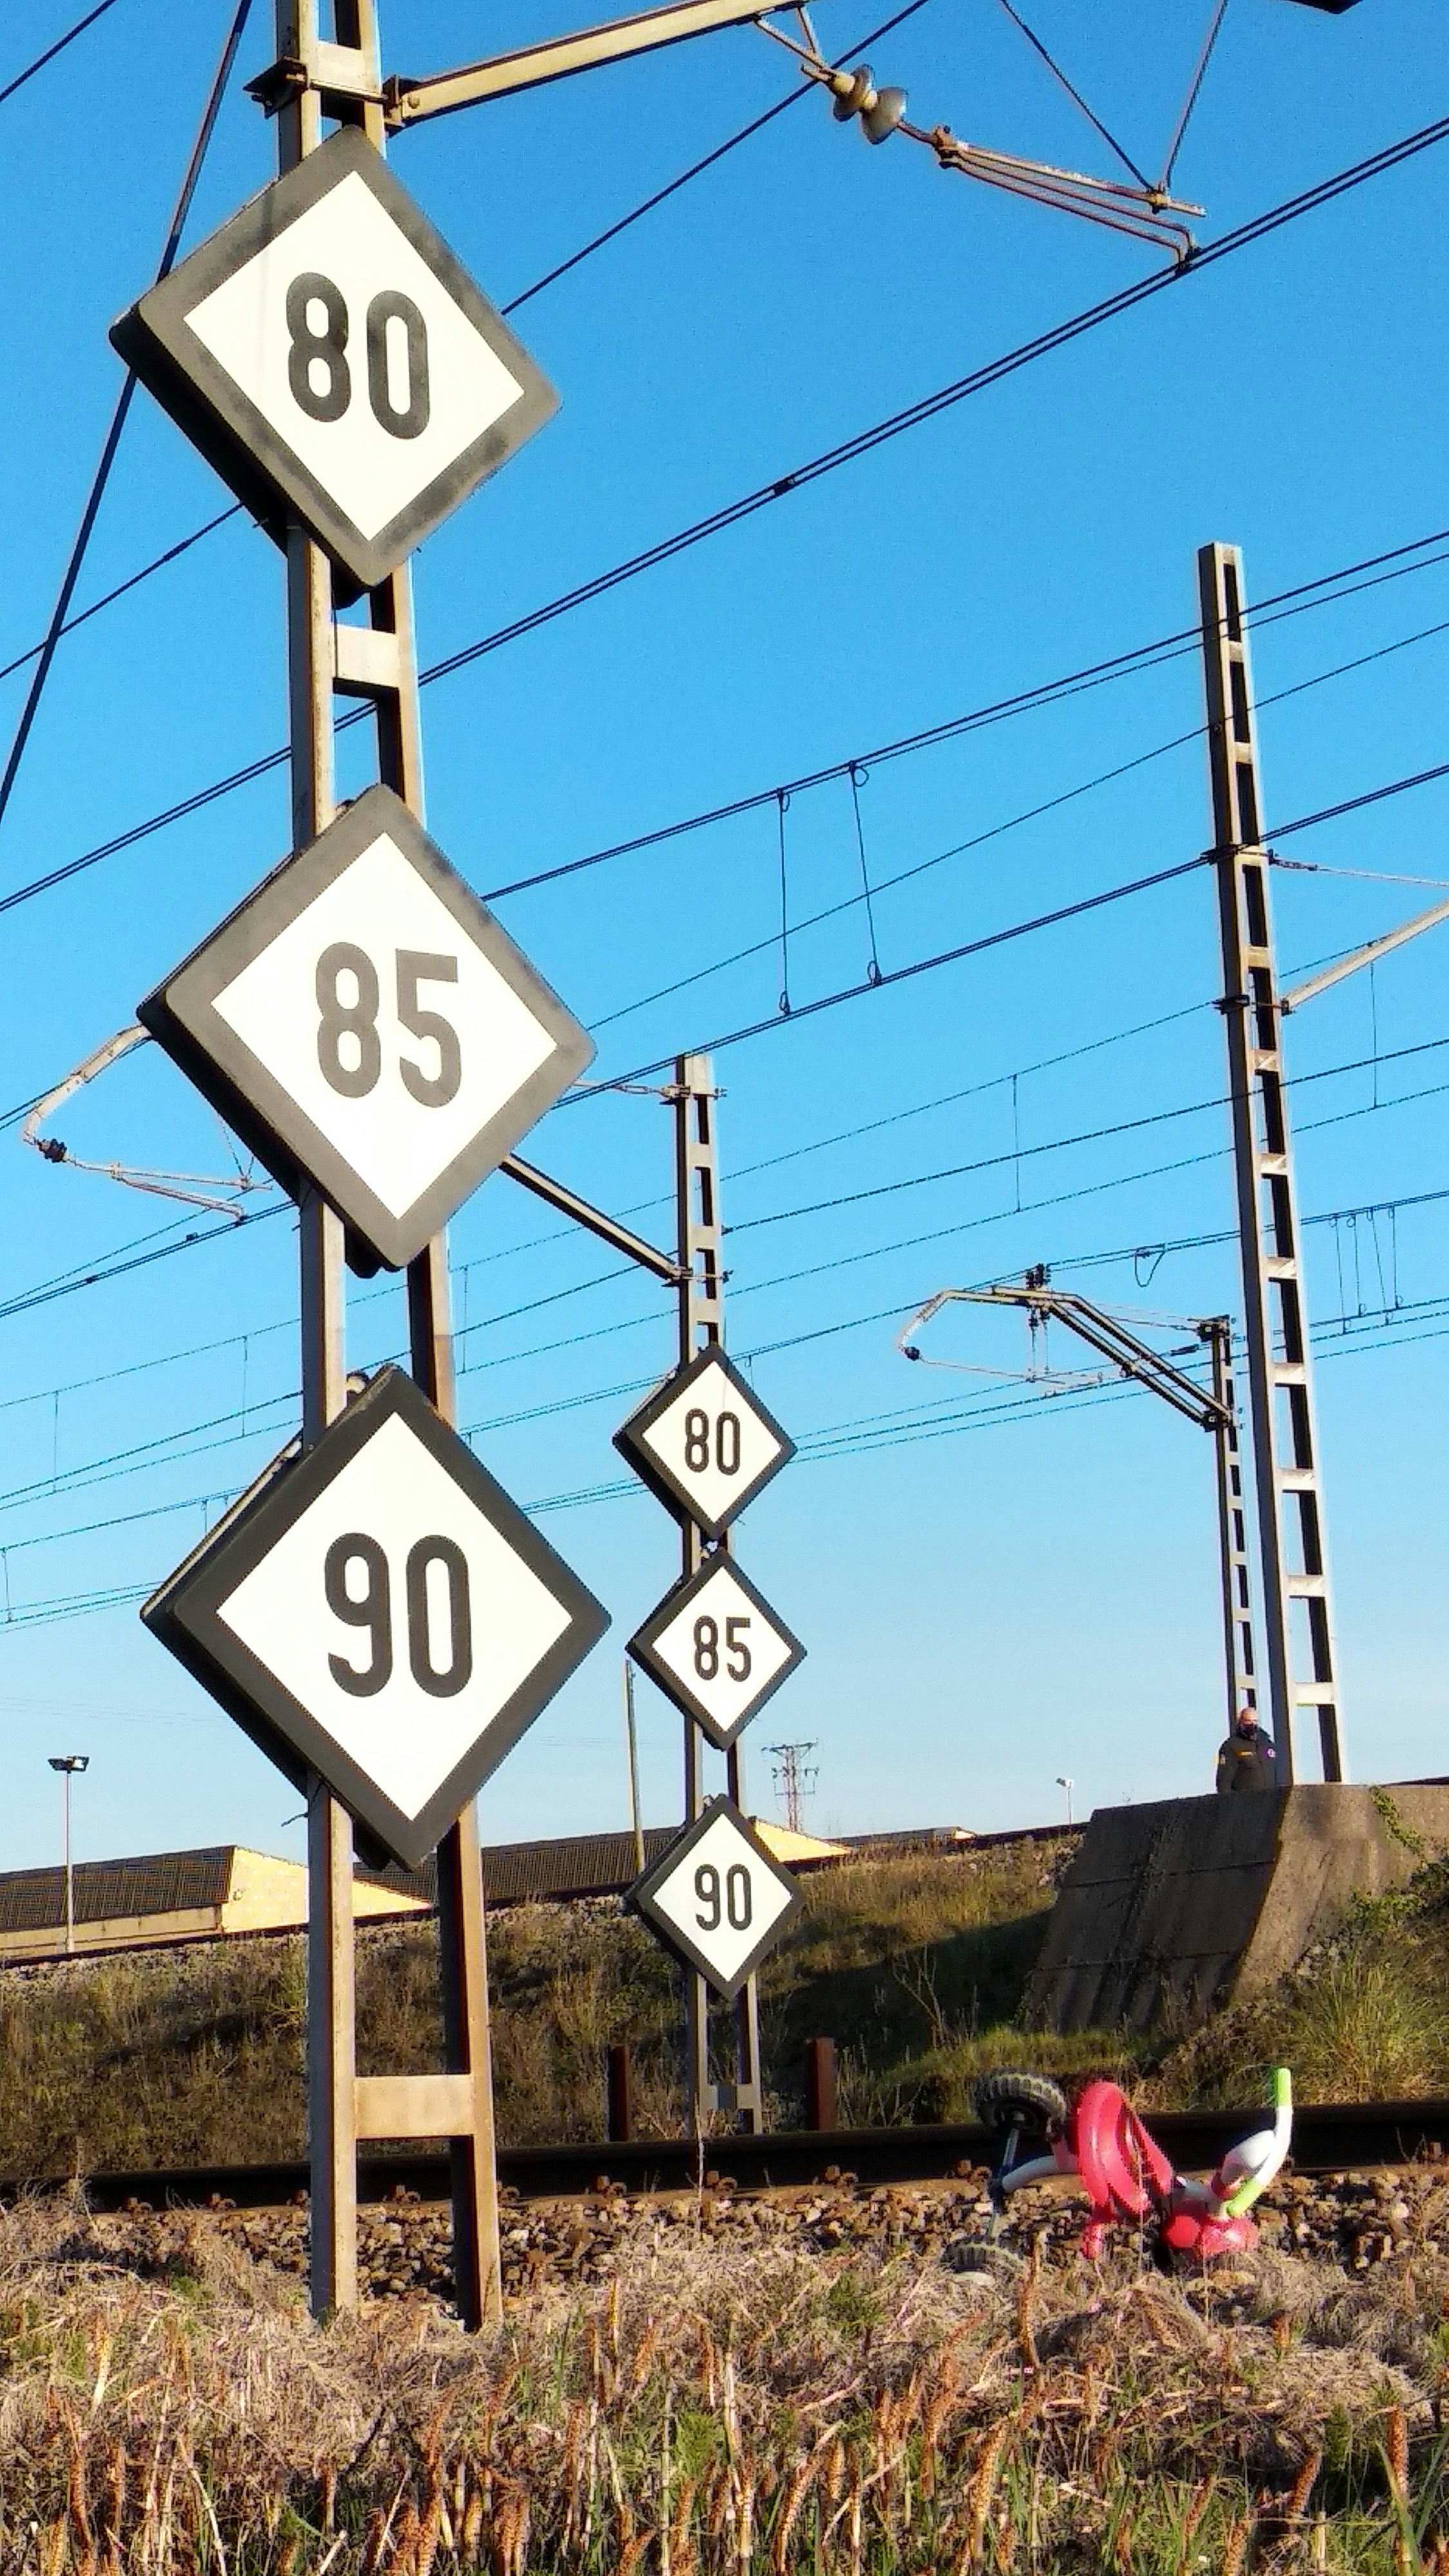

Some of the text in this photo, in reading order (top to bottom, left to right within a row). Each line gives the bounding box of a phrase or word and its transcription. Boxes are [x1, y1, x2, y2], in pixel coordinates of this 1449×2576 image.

[286, 272, 431, 440] 80
[316, 942, 462, 1108] 85
[685, 1408, 741, 1476] 80
[324, 1532, 473, 1698] 90
[693, 1615, 752, 1683] 85
[694, 1864, 753, 1931] 90
